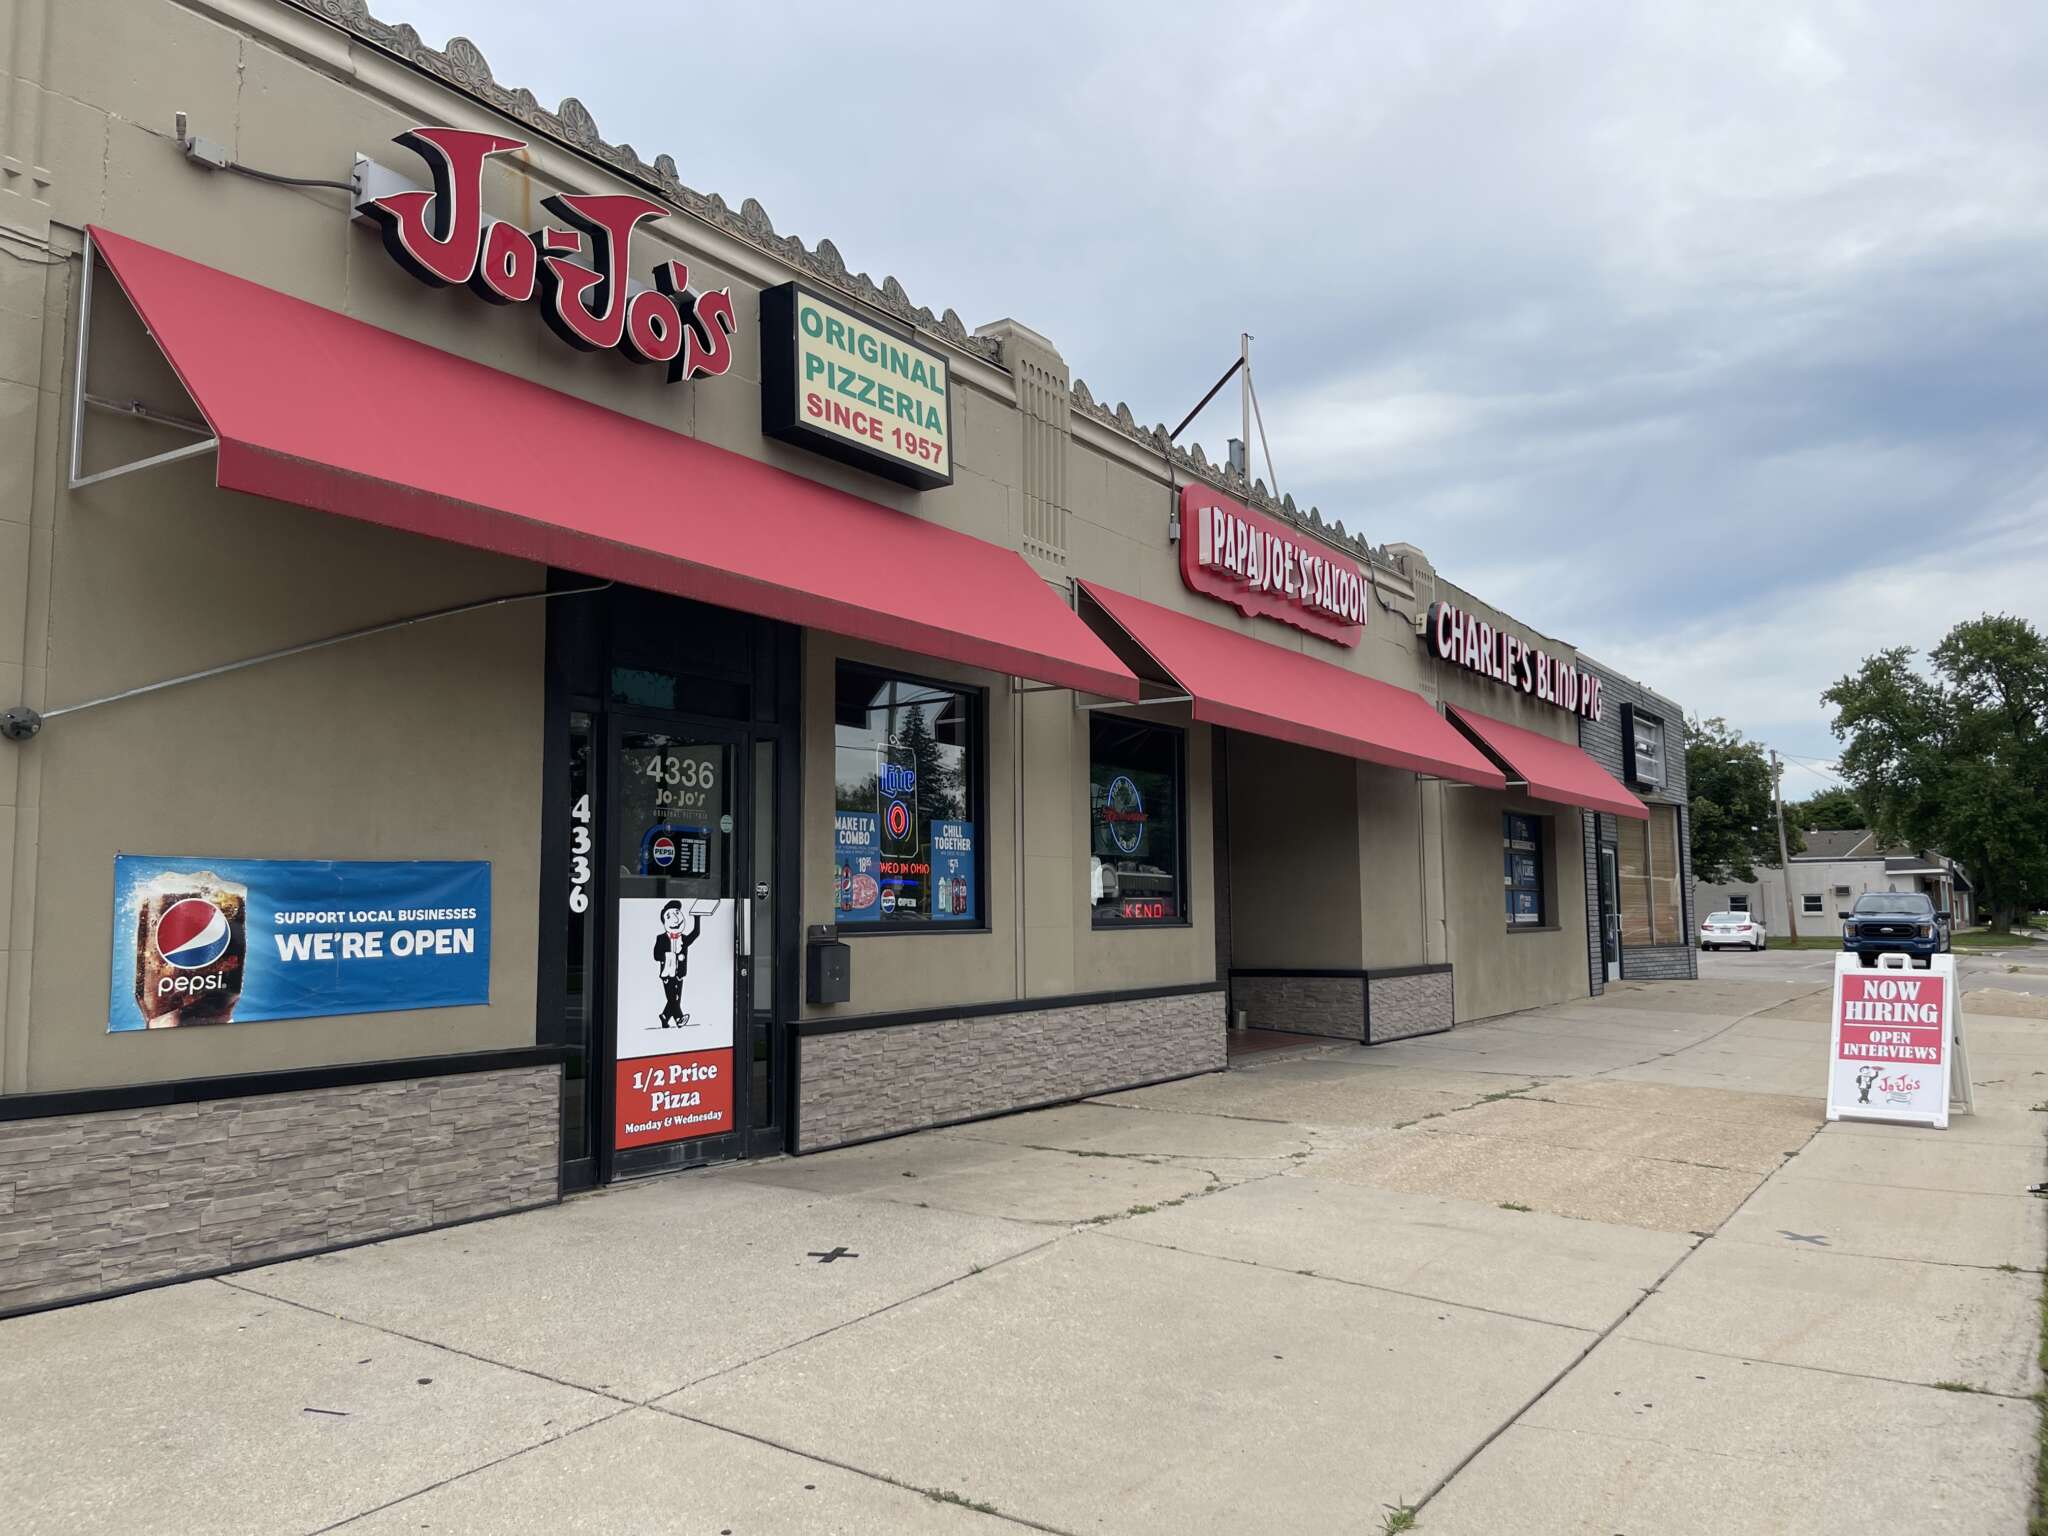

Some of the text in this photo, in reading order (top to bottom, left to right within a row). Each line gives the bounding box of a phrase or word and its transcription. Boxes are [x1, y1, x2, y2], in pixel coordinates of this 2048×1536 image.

[360, 127, 738, 382] Jo-Jo's
[800, 307, 945, 396] ORIGINAL
[805, 352, 943, 435] PIZZERIA
[807, 392, 943, 464] SINCE 1957
[1211, 506, 1368, 625] PAPA JOE'S SALOON
[1436, 600, 1603, 722] CHARLIE'S BLIND PIG
[647, 755, 714, 789] 4336
[879, 762, 915, 799] Lite
[834, 816, 876, 833] MAKE IT A
[942, 825, 962, 838] CHILL
[840, 830, 870, 845] COMBO
[934, 837, 971, 851] TOGETHER
[655, 847, 674, 855] PEPSI
[910, 863, 930, 874] OHIO
[897, 897, 917, 907] OPEN
[1124, 903, 1163, 918] KENO
[274, 908, 477, 924] SUPPORT LOCAL BUSINESSES
[274, 928, 475, 961] WE'RE OPEN
[158, 971, 224, 996] pepsi
[1863, 980, 1921, 1001] NOW
[1844, 1000, 1939, 1024] HIRING
[1869, 1030, 1911, 1044] OPEN
[1843, 1043, 1937, 1060] INTERVIEWS
[633, 1063, 718, 1092] 1/2 Price
[651, 1091, 700, 1112] Pizza
[625, 1110, 723, 1134] Monday & Wednesday
